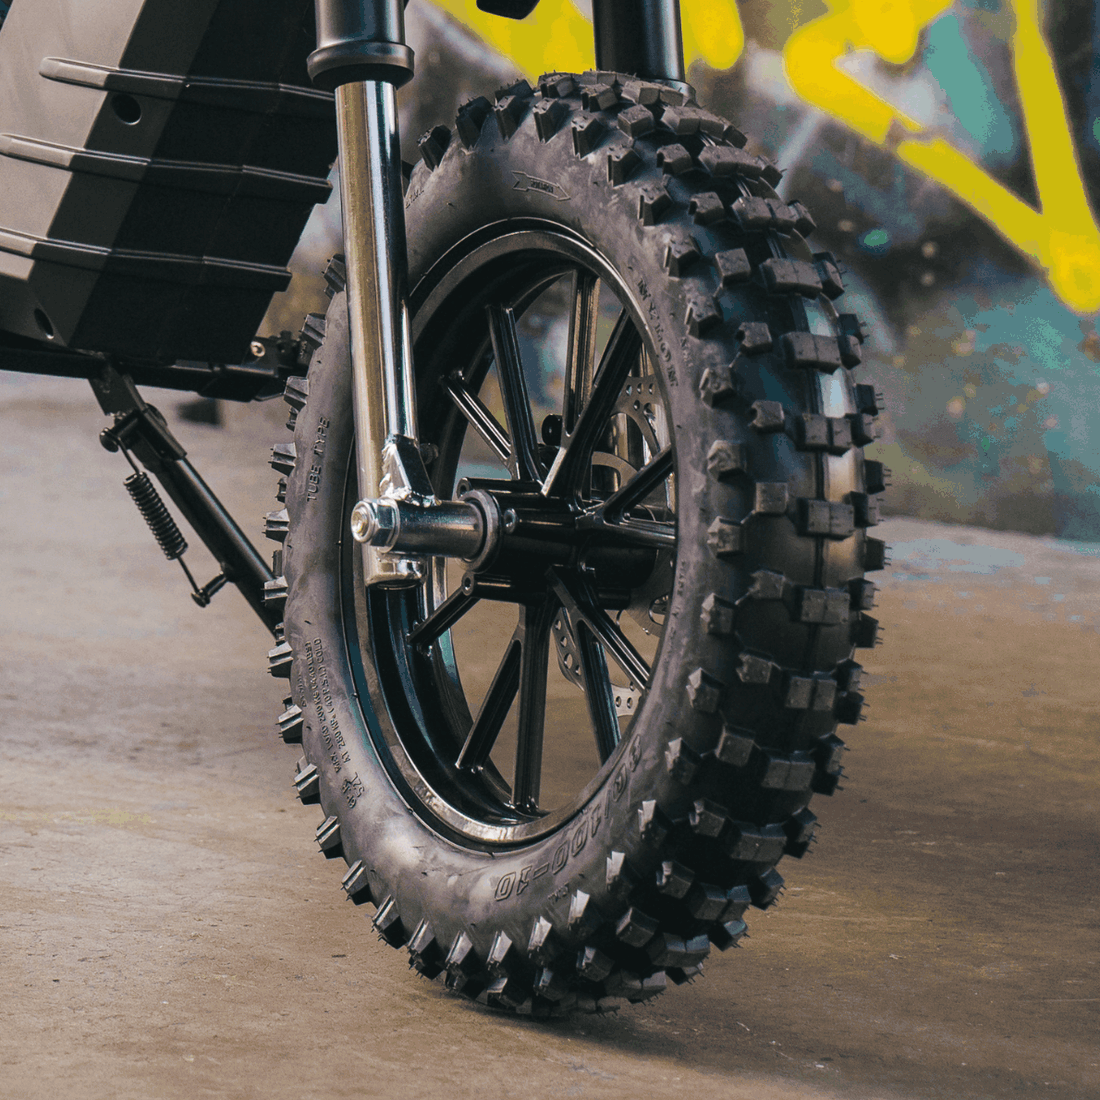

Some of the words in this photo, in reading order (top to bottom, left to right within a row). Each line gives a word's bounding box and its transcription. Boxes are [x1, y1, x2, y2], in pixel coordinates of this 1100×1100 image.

[313, 416, 330, 455] TYPE
[307, 465, 321, 502] TUBE
[313, 637, 325, 663] COLD
